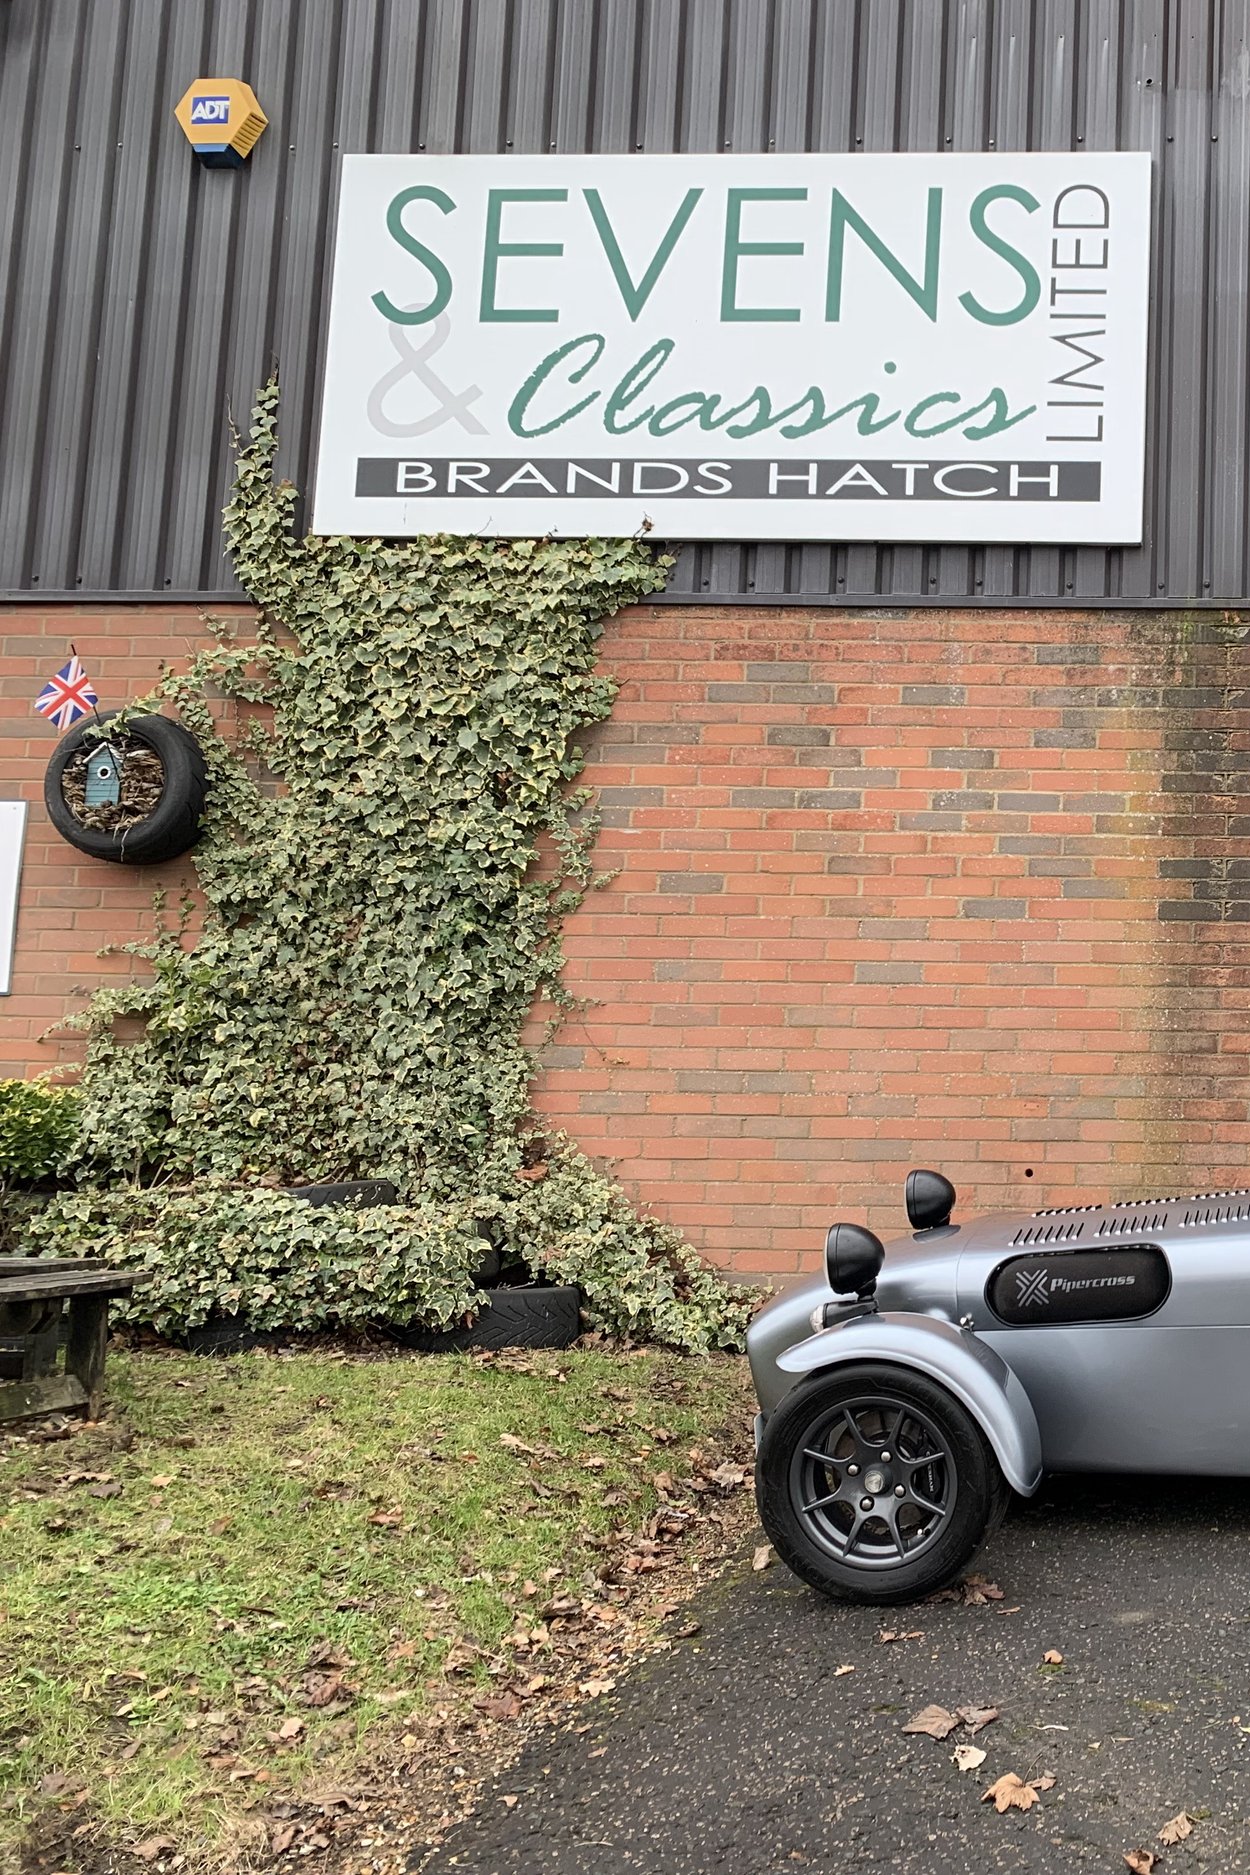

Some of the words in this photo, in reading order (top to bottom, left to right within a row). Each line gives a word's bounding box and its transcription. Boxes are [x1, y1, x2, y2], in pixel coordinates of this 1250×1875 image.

[191, 100, 230, 120] ADT
[371, 183, 1042, 326] SEVENS
[1046, 184, 1110, 442] LIMITED
[365, 301, 487, 440] &
[506, 333, 1036, 440] Classics
[396, 461, 733, 495] BRANDS
[768, 462, 1059, 497] HATCH
[1049, 1275, 1136, 1294] Pipercross
